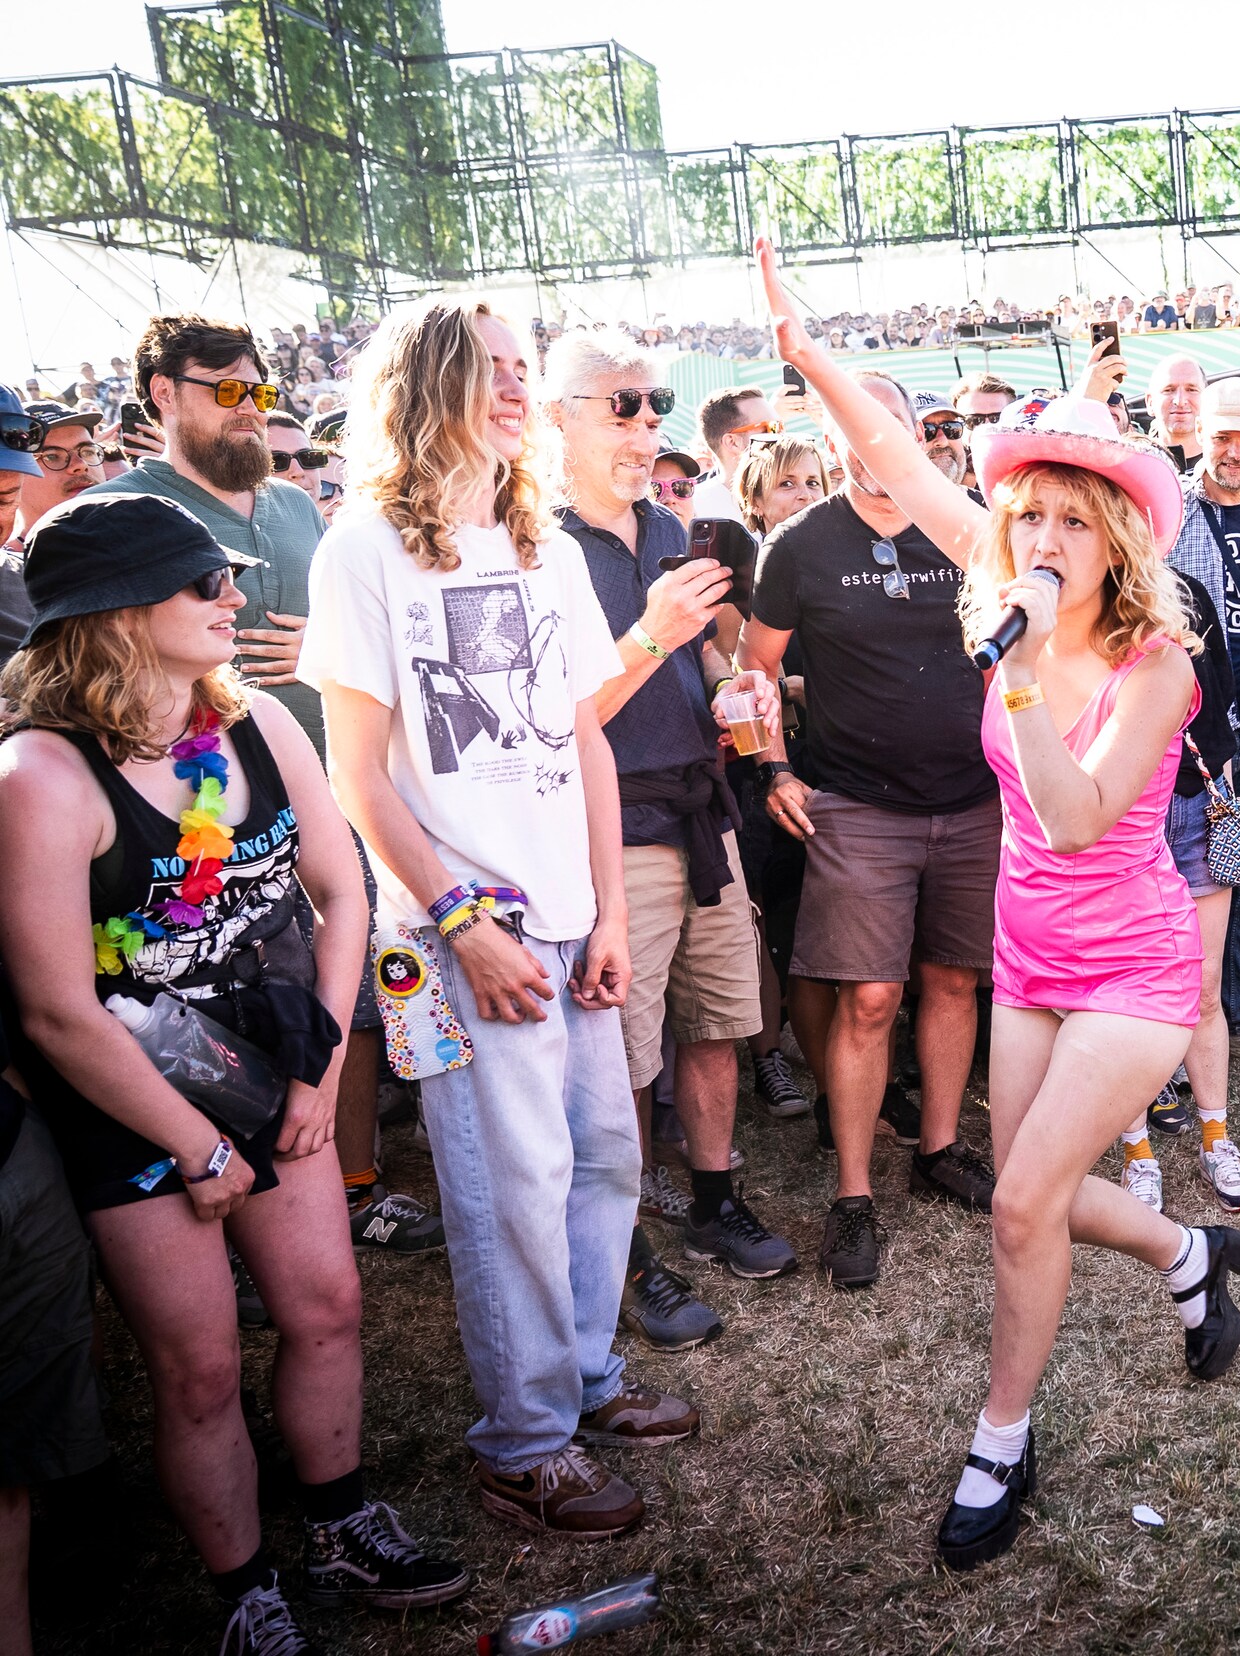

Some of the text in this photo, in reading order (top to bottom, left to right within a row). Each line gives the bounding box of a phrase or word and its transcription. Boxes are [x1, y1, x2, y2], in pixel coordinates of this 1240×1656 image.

[151, 806, 297, 878] NOING BAK
[362, 1216, 398, 1243] N
